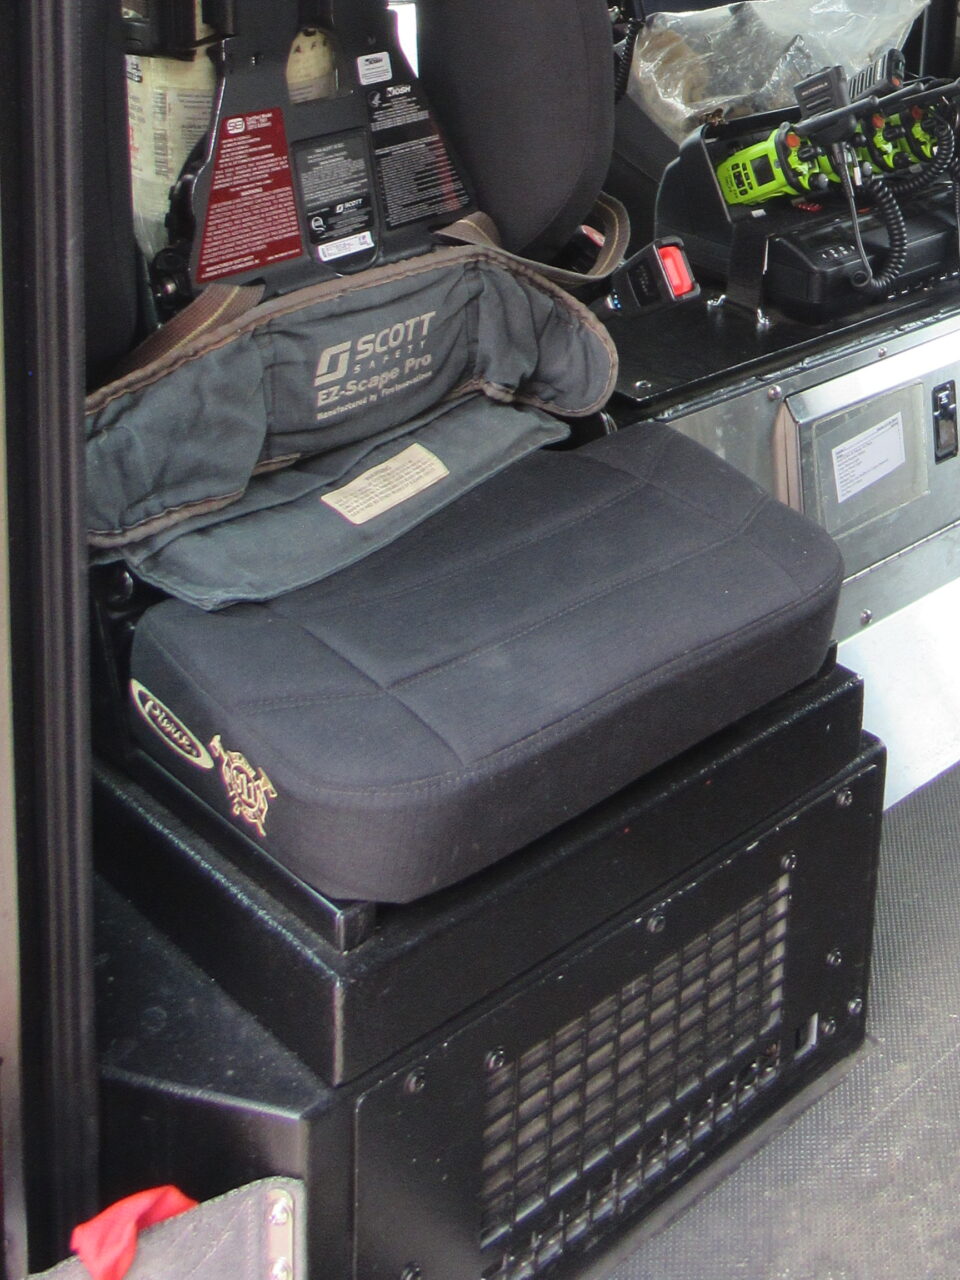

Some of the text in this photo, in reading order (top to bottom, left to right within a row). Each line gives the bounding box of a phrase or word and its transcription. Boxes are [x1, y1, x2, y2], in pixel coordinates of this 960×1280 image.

[353, 340, 426, 374] SAFETY
[355, 311, 437, 361] SCOTT
[317, 353, 432, 407] EZ-Scape Pro
